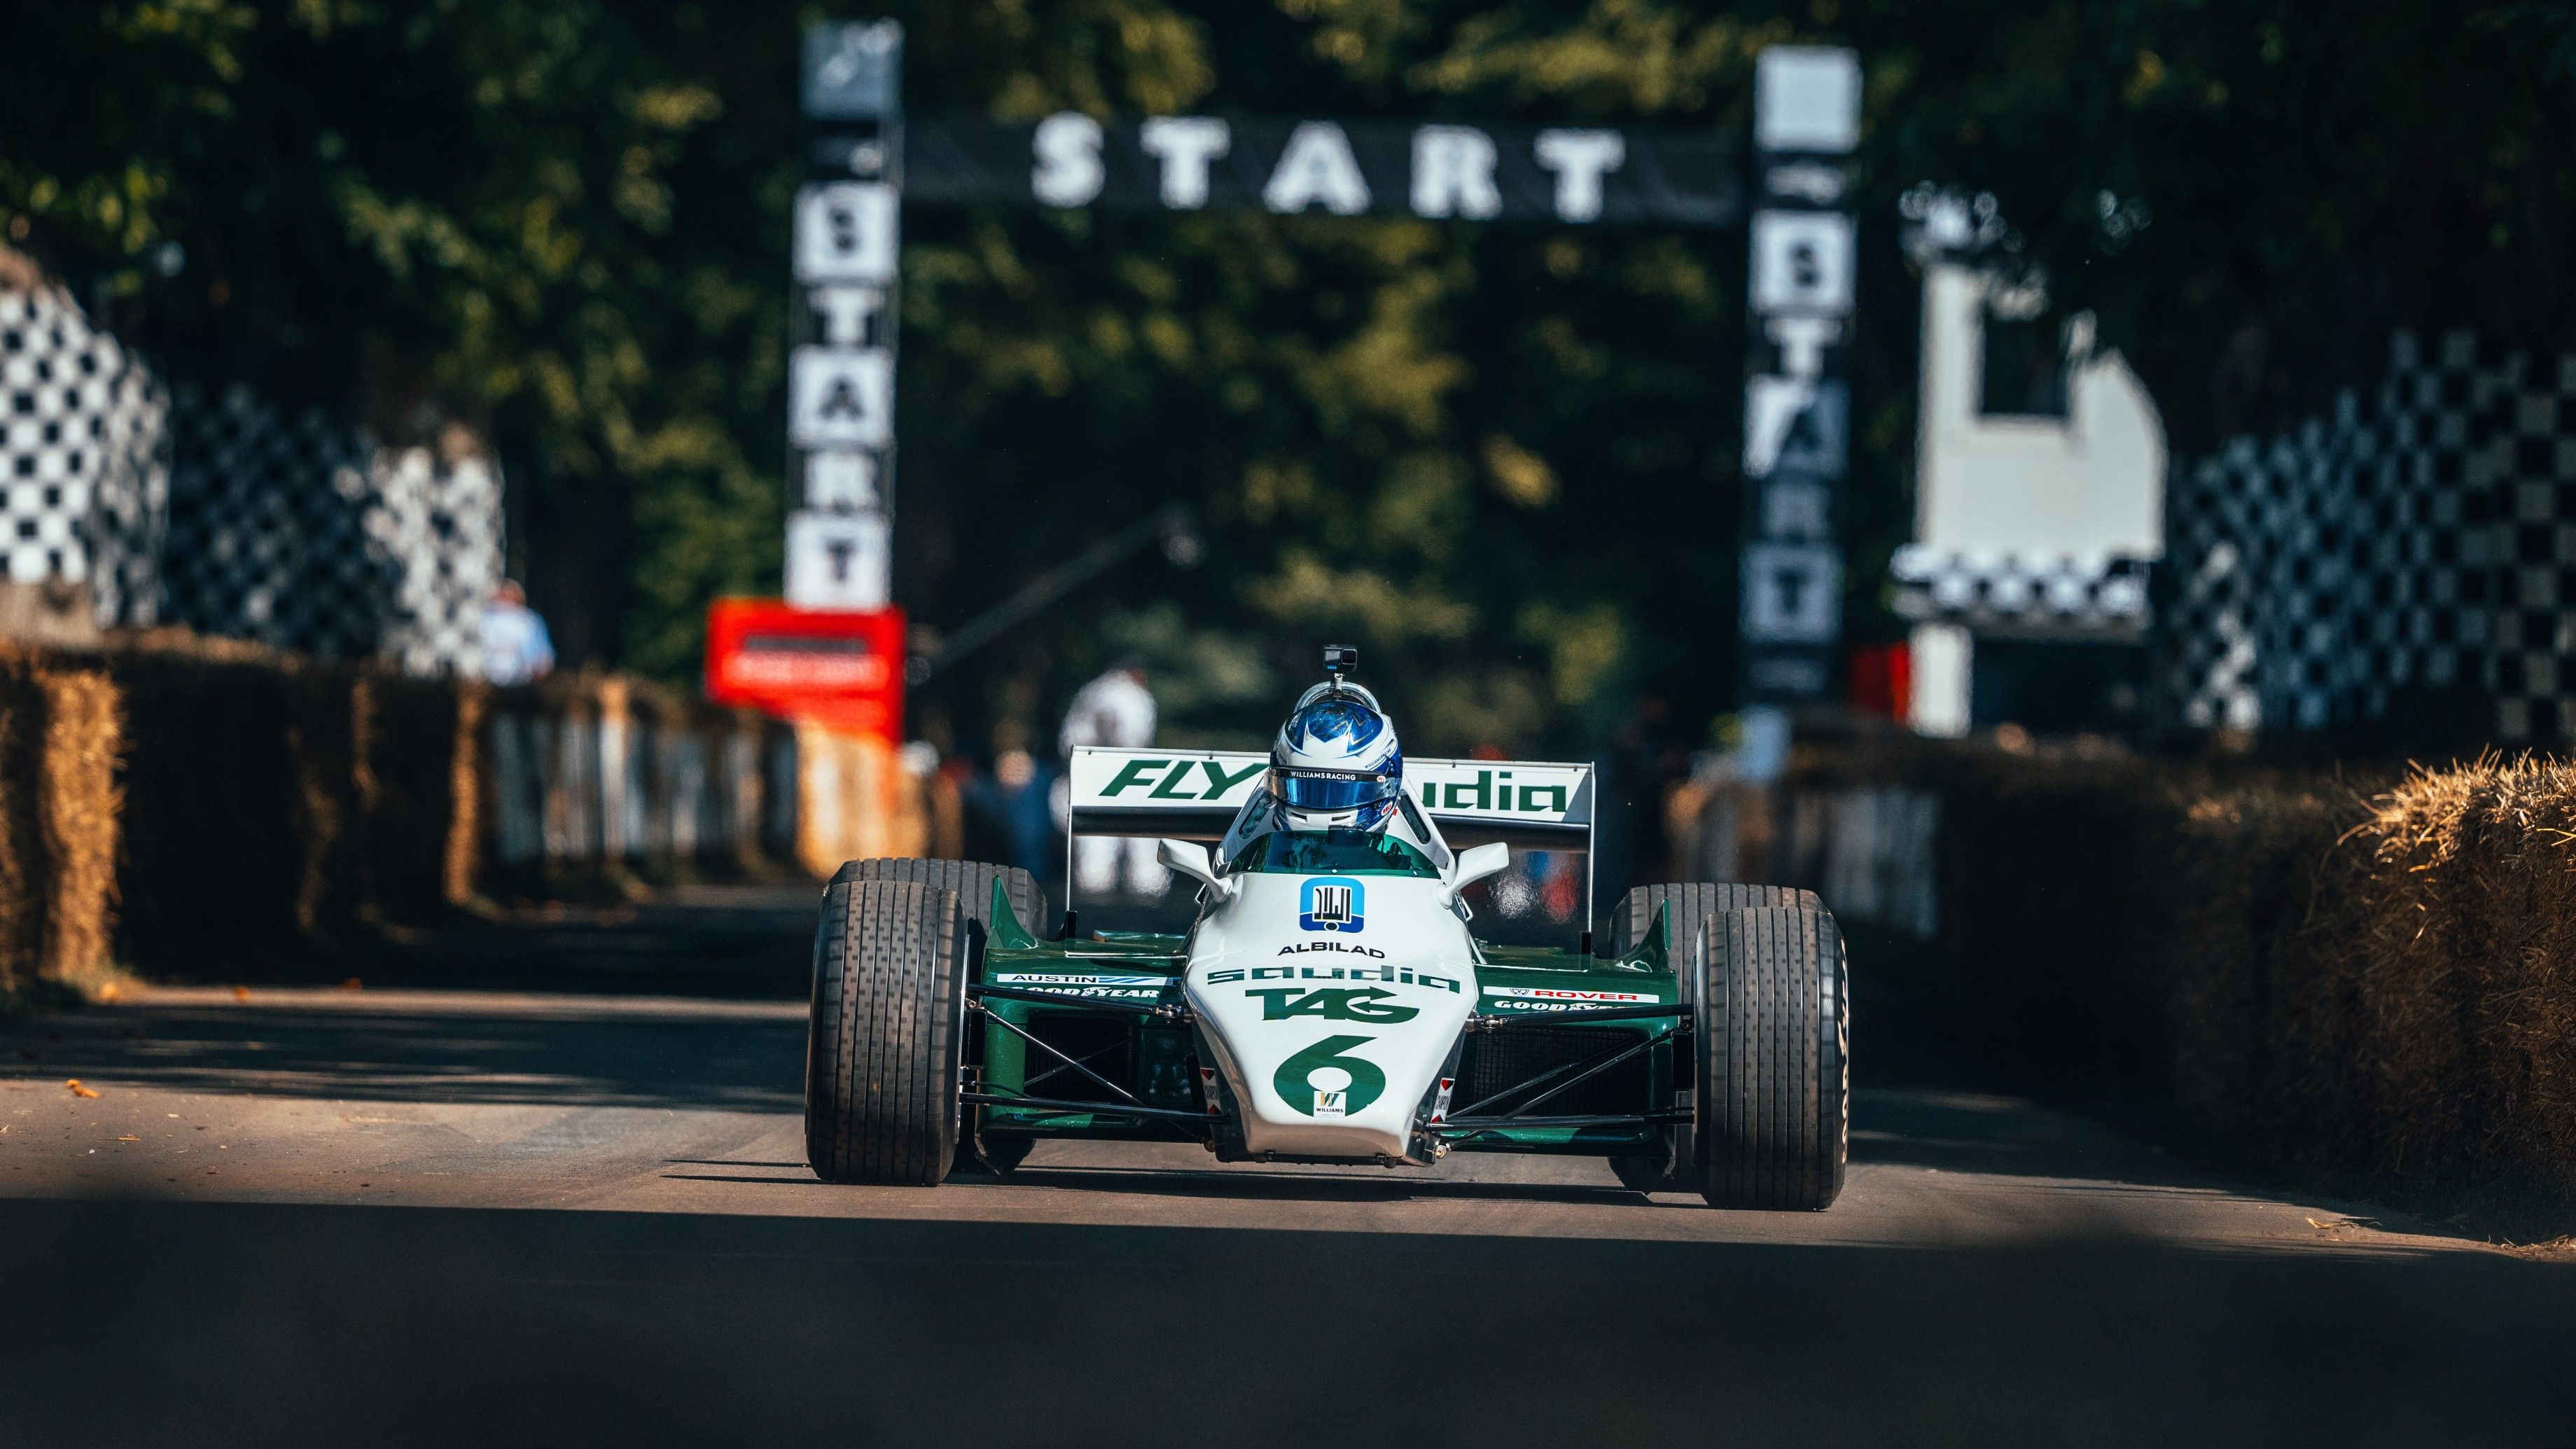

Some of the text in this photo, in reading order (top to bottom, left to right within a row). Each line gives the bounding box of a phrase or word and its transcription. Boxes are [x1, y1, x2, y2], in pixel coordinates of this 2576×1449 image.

[1031, 110, 1626, 223] START
[805, 209, 884, 584] START
[1098, 759, 1269, 800] FLY
[1277, 941, 1386, 959] ALBILAD
[1012, 974, 1096, 983] AUSTIN
[1012, 985, 1160, 997] OODYEAR
[1207, 964, 1461, 994] saudia
[1245, 986, 1421, 1025] TAG
[1494, 1000, 1641, 1011] GOODY
[1534, 990, 1638, 1001] ROVER
[1272, 1034, 1387, 1117] 6
